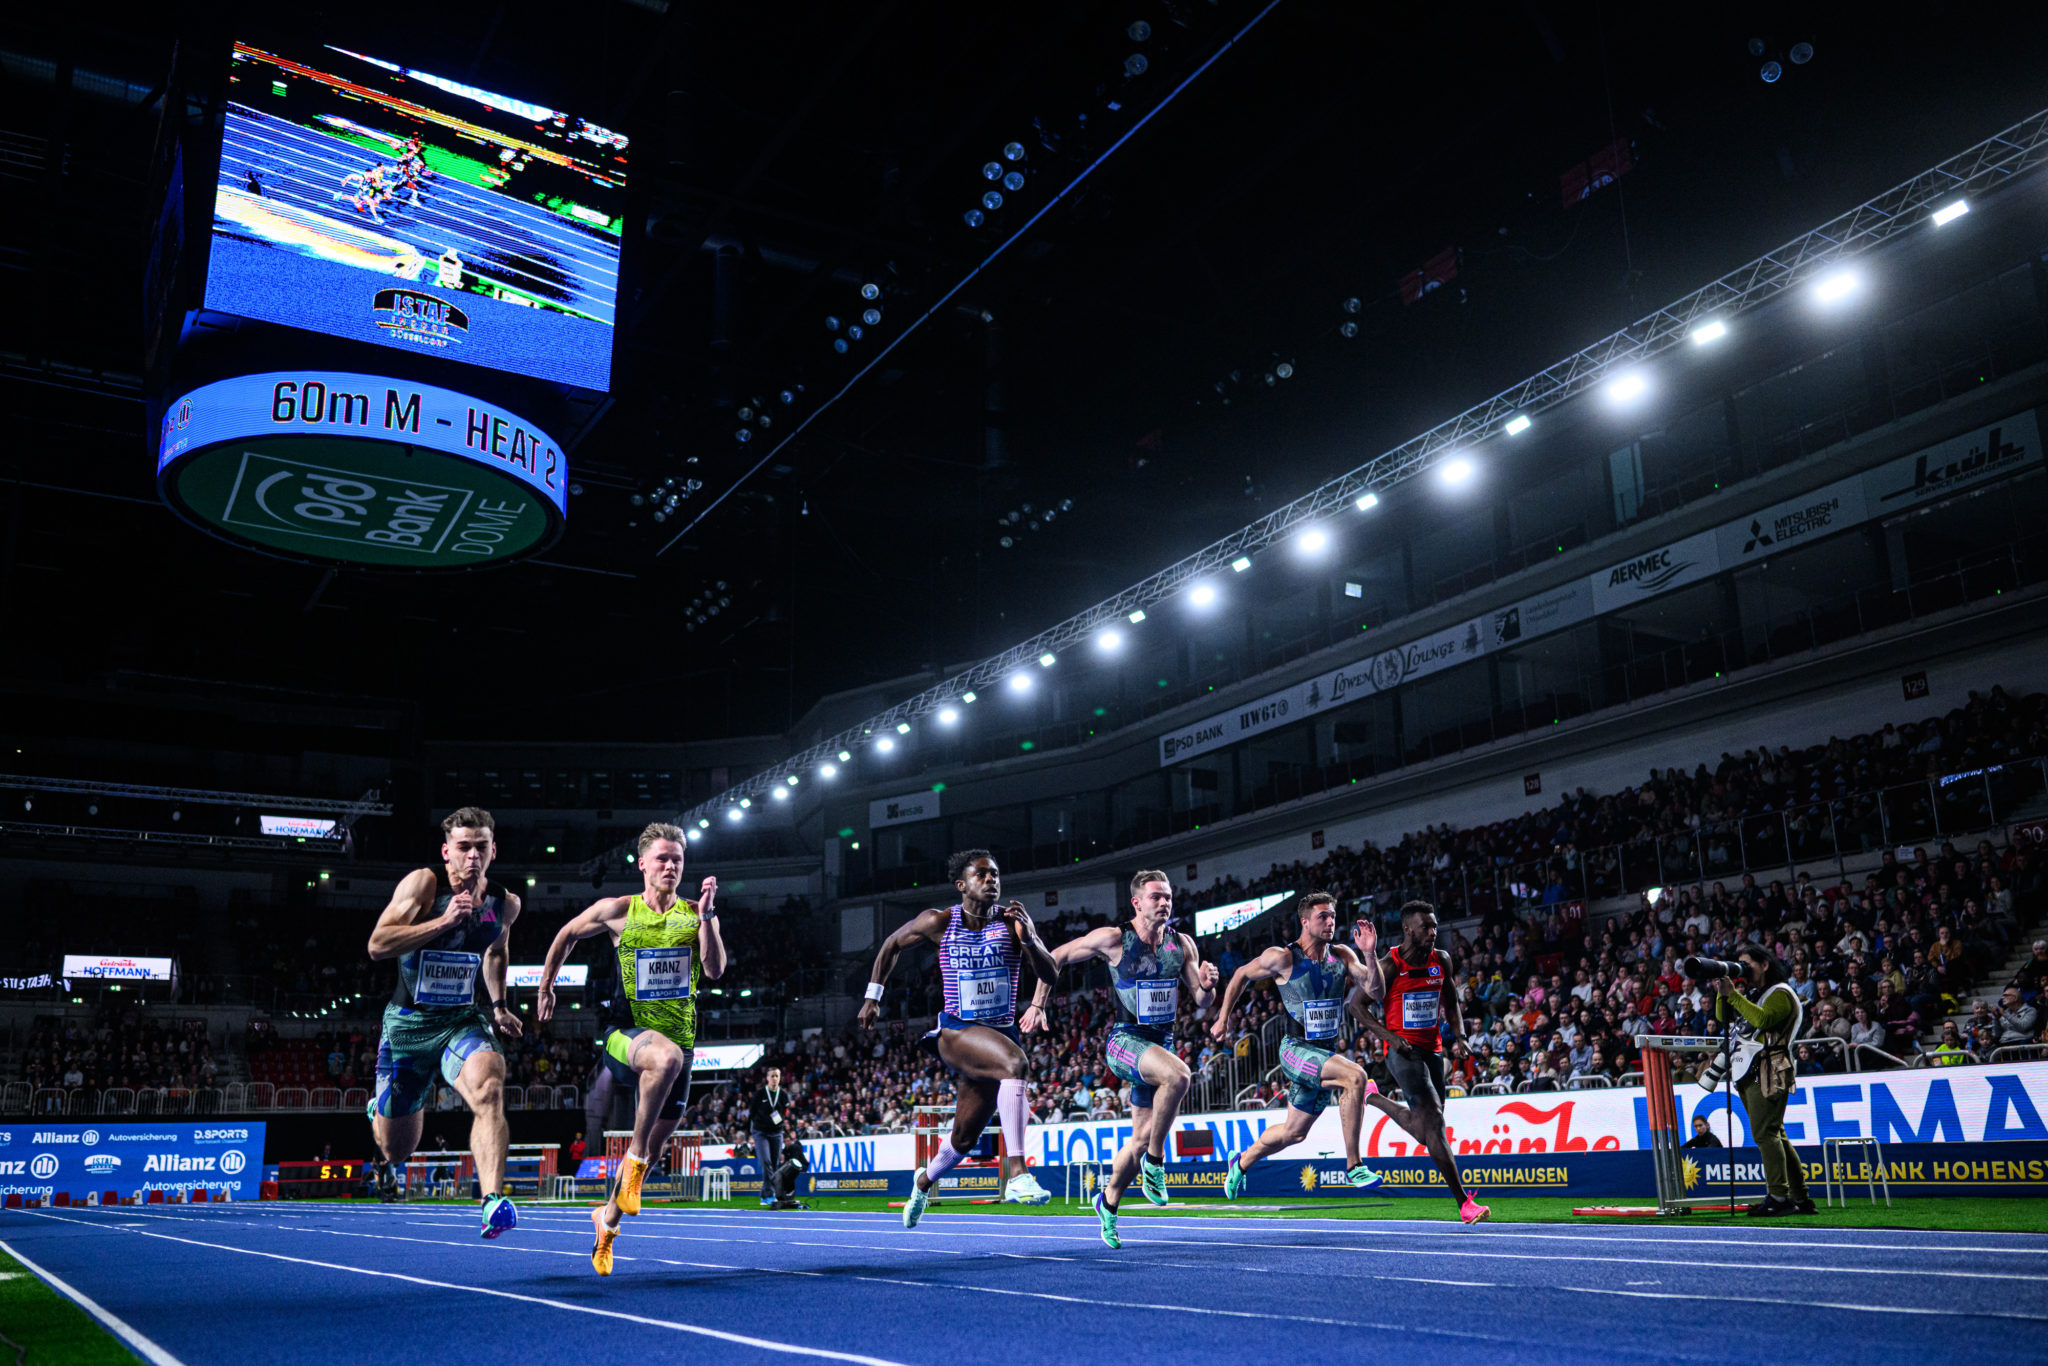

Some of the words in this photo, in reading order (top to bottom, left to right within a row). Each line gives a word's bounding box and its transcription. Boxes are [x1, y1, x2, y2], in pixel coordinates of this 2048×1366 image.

[393, 292, 451, 326] ISTAF
[271, 381, 370, 426] 60m
[384, 389, 422, 433] M
[465, 408, 542, 476] HEAT
[544, 447, 557, 491] 2
[364, 489, 449, 547] Bank
[1774, 497, 1839, 531] MITSUBISHI
[451, 498, 526, 556] DOME
[1775, 513, 1832, 542] ELECTRIC
[1608, 550, 1671, 587] AERMEC
[1904, 679, 1925, 696] 129
[1176, 736, 1193, 752] PSD
[1196, 724, 1223, 745] BANK
[949, 944, 1003, 957] GREAT
[649, 961, 680, 974] KRANZ
[950, 956, 1004, 968] BRITAIN
[84, 966, 151, 977] HOFFMANN
[977, 981, 994, 995] AZU
[970, 998, 993, 1006] Allianz
[1150, 991, 1170, 1002] WOLF
[1309, 1010, 1323, 1021] VAN
[32, 1132, 79, 1144] Allianz
[108, 1133, 178, 1142] Autoversicherung
[194, 1129, 248, 1140] D.SPORTS
[1366, 1100, 1620, 1158] Gtränke
[1043, 1118, 1267, 1168] HOFFNN
[143, 1153, 216, 1172] Allianz
[1192, 1171, 1228, 1186] AACHE
[1429, 1169, 1447, 1184] BA
[1462, 1168, 1569, 1184] OEYNHAUSEN
[1800, 1162, 1926, 1181] SPELBANK
[142, 1180, 241, 1191] Autoversicherung
[838, 1180, 859, 1189] CASINO
[860, 1178, 888, 1189] DUISBURG
[959, 1176, 998, 1187] SPIELBANK
